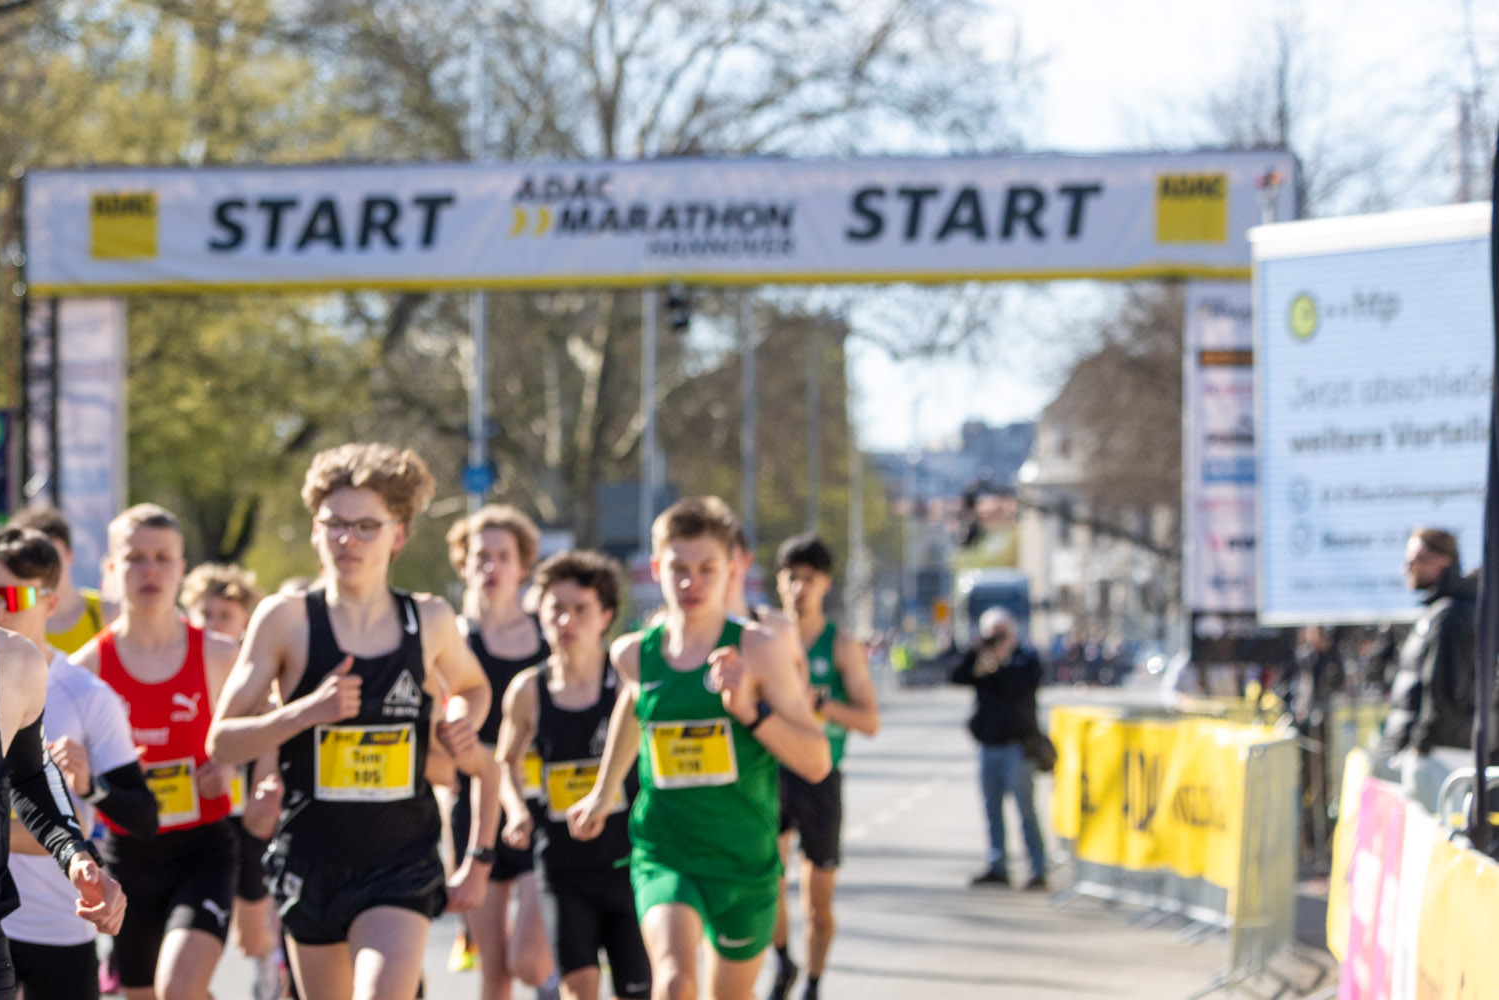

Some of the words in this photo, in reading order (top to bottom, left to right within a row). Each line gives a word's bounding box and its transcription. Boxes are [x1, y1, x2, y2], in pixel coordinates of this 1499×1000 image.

[512, 172, 612, 202] ADAC
[208, 193, 456, 254] START
[555, 202, 796, 237] MARATHON
[845, 183, 1105, 244] START
